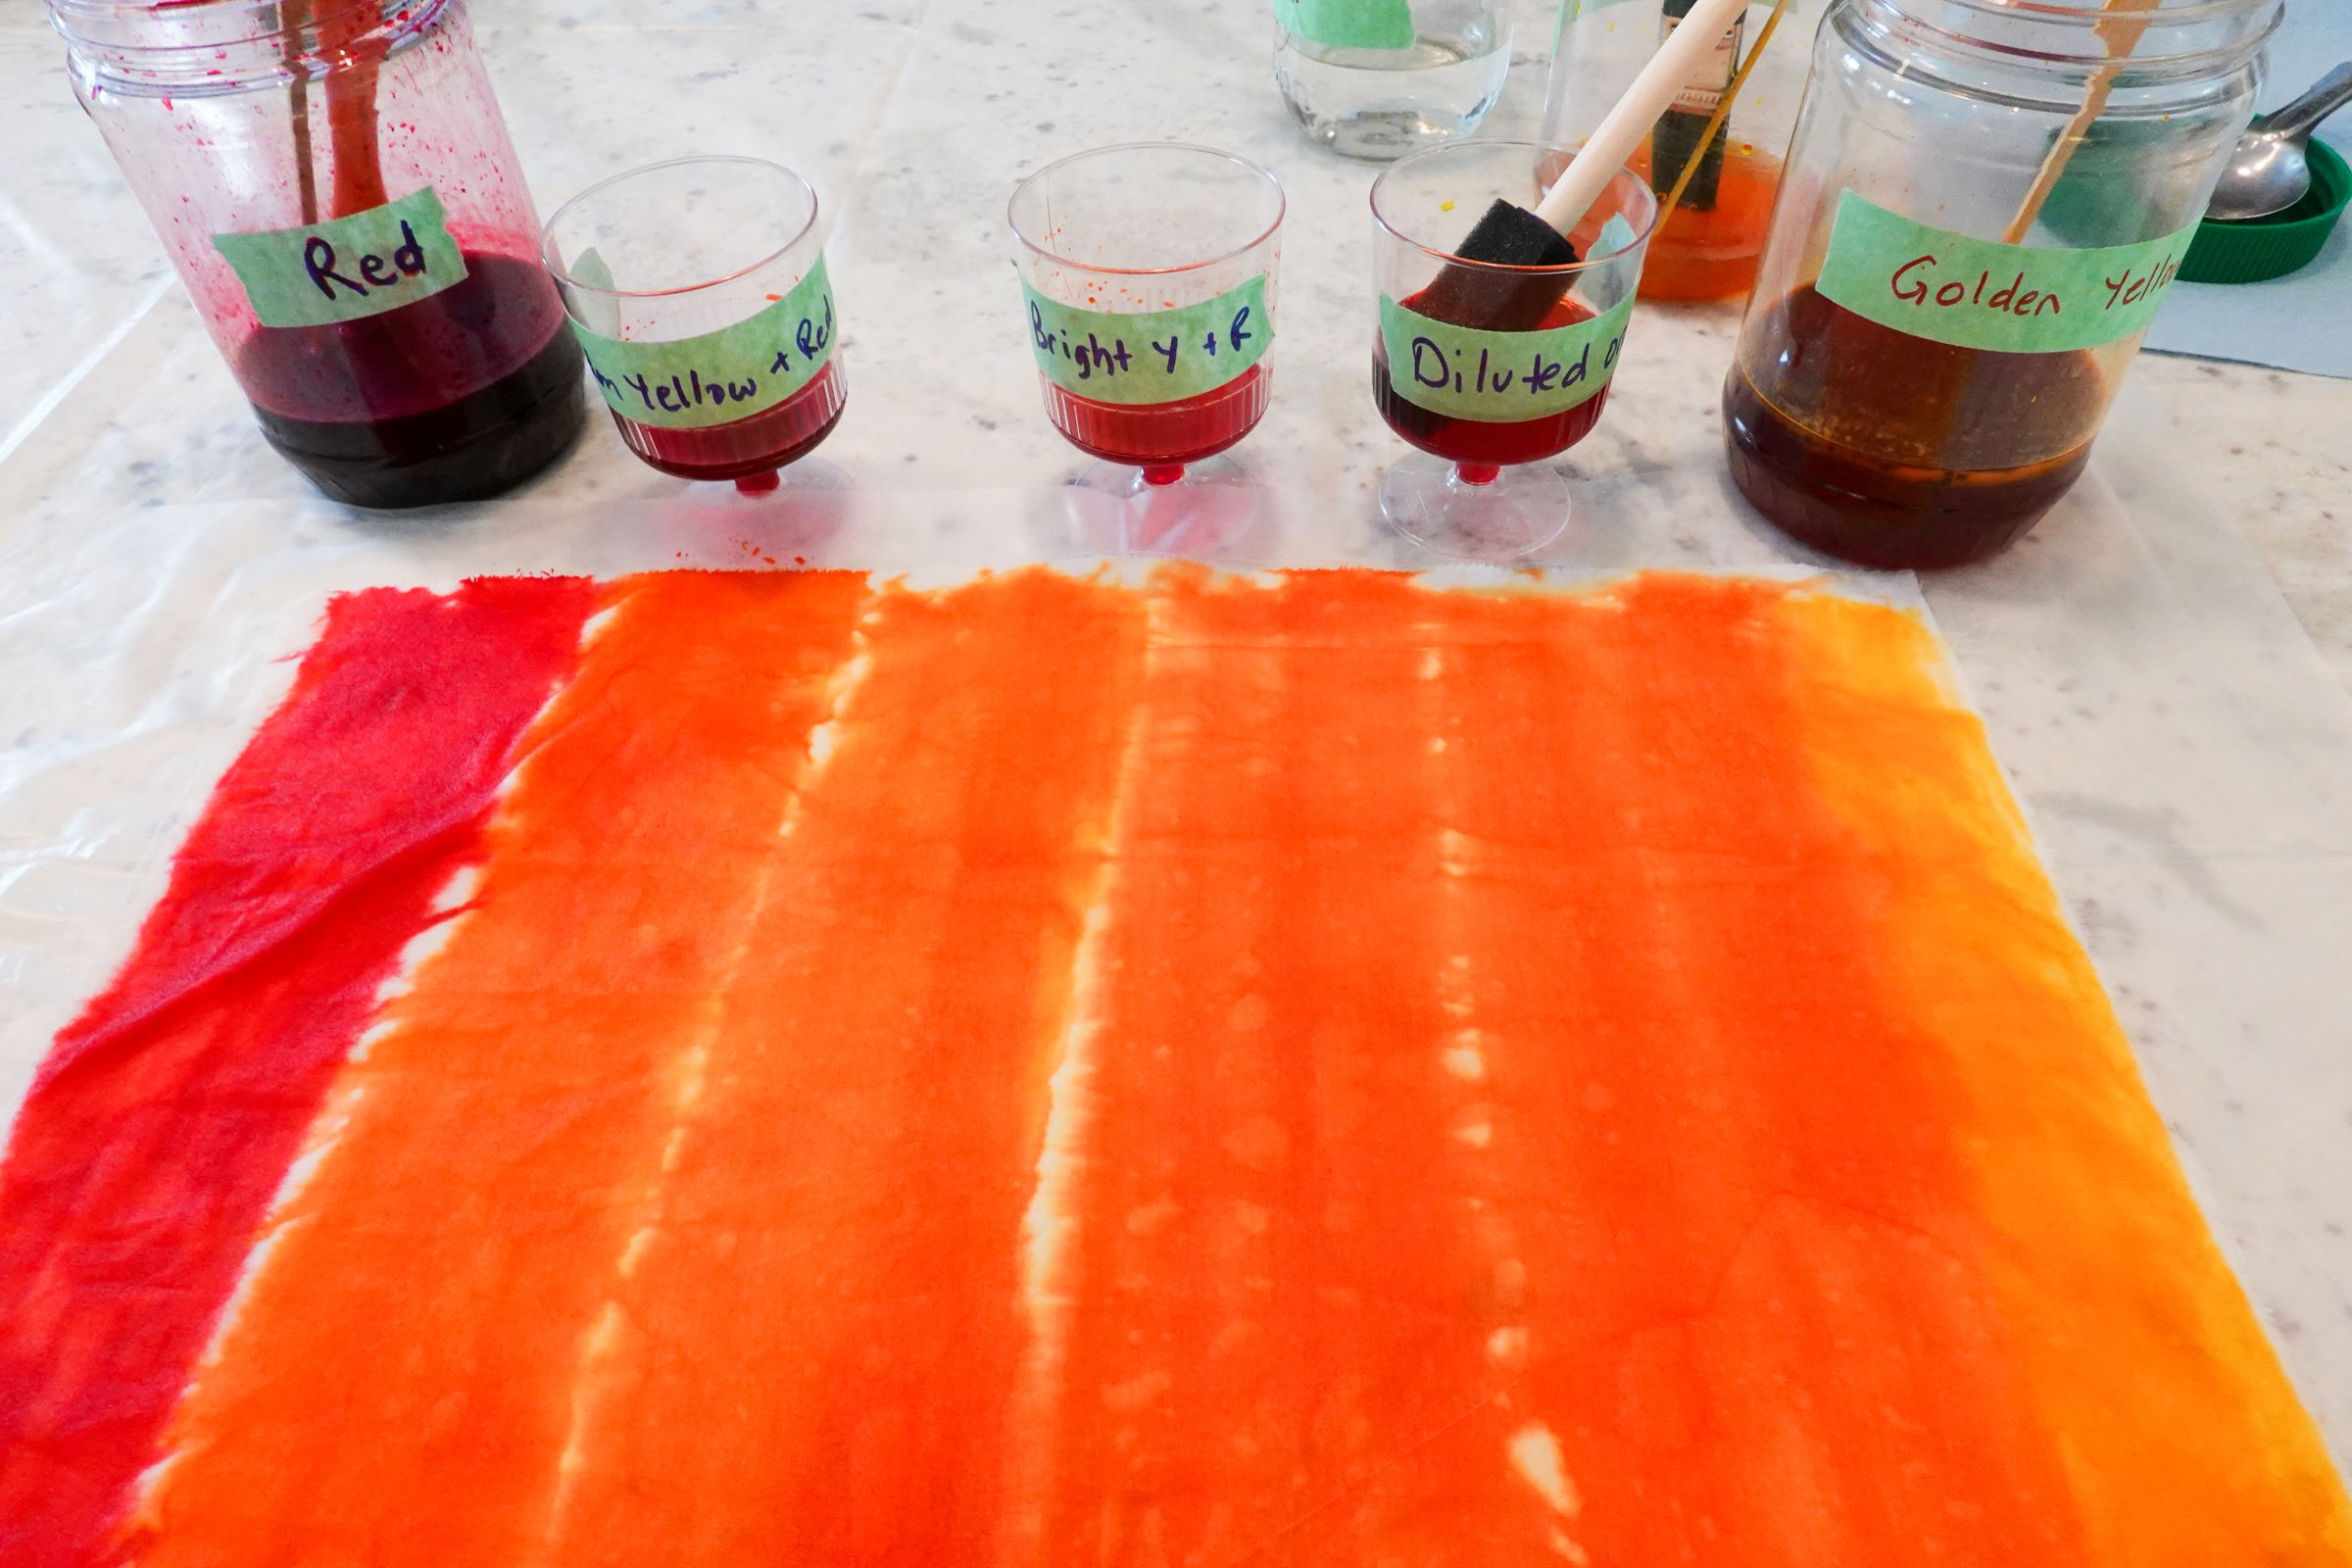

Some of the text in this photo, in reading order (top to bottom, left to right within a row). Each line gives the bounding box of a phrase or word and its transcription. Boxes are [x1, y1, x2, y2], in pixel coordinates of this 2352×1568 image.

[304, 219, 427, 301] Red
[1890, 254, 2062, 318] Golden
[622, 369, 758, 413] Yellow
[796, 293, 832, 362] Red
[1030, 299, 1133, 380] Bright
[1201, 331, 1217, 357] +
[1229, 305, 1252, 353] R
[1411, 335, 1591, 396] Diluted
